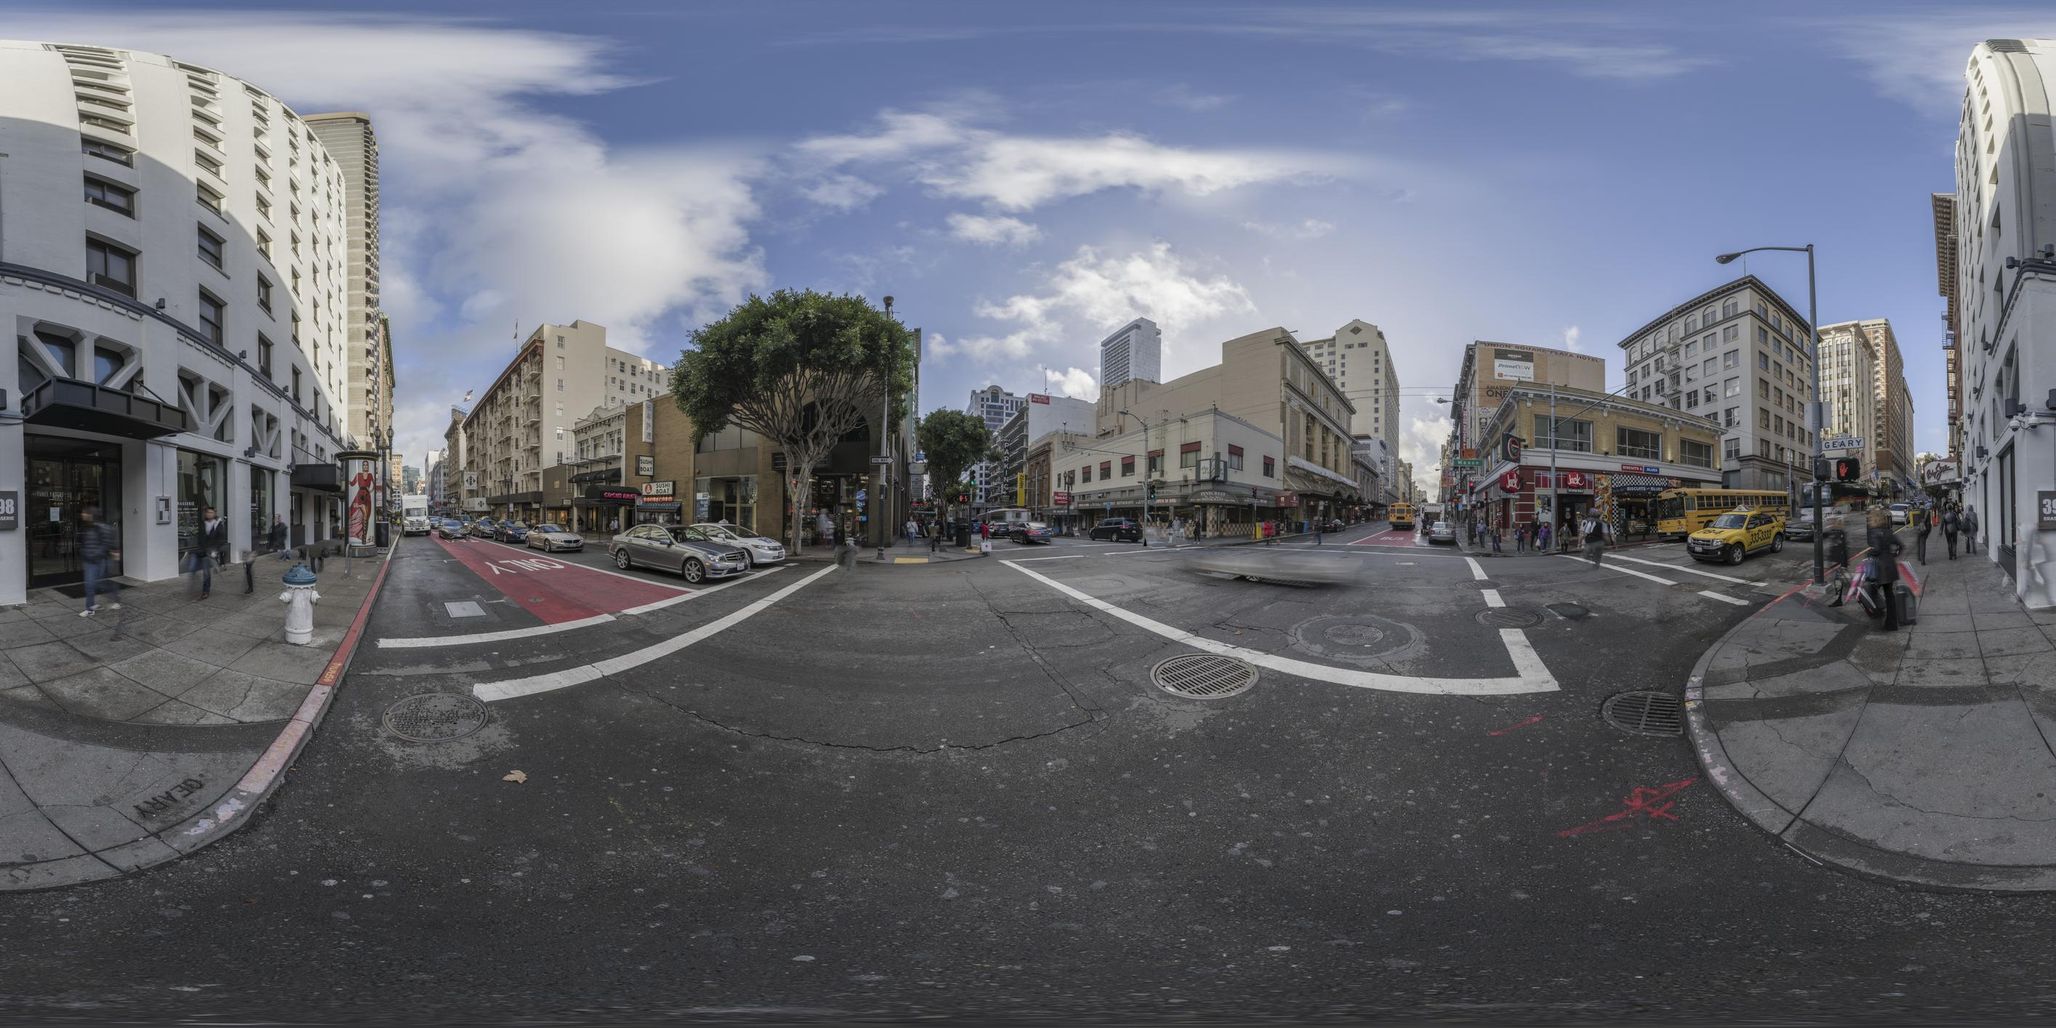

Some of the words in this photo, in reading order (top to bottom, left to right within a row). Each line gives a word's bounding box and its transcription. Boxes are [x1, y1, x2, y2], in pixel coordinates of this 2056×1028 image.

[1484, 342, 1512, 350] UNION
[1576, 353, 1600, 363] HOTEL
[1824, 439, 1862, 449] GEARY
[1567, 473, 1585, 486] Jack
[484, 558, 565, 575] ONLY
[133, 778, 204, 818] GEARY
